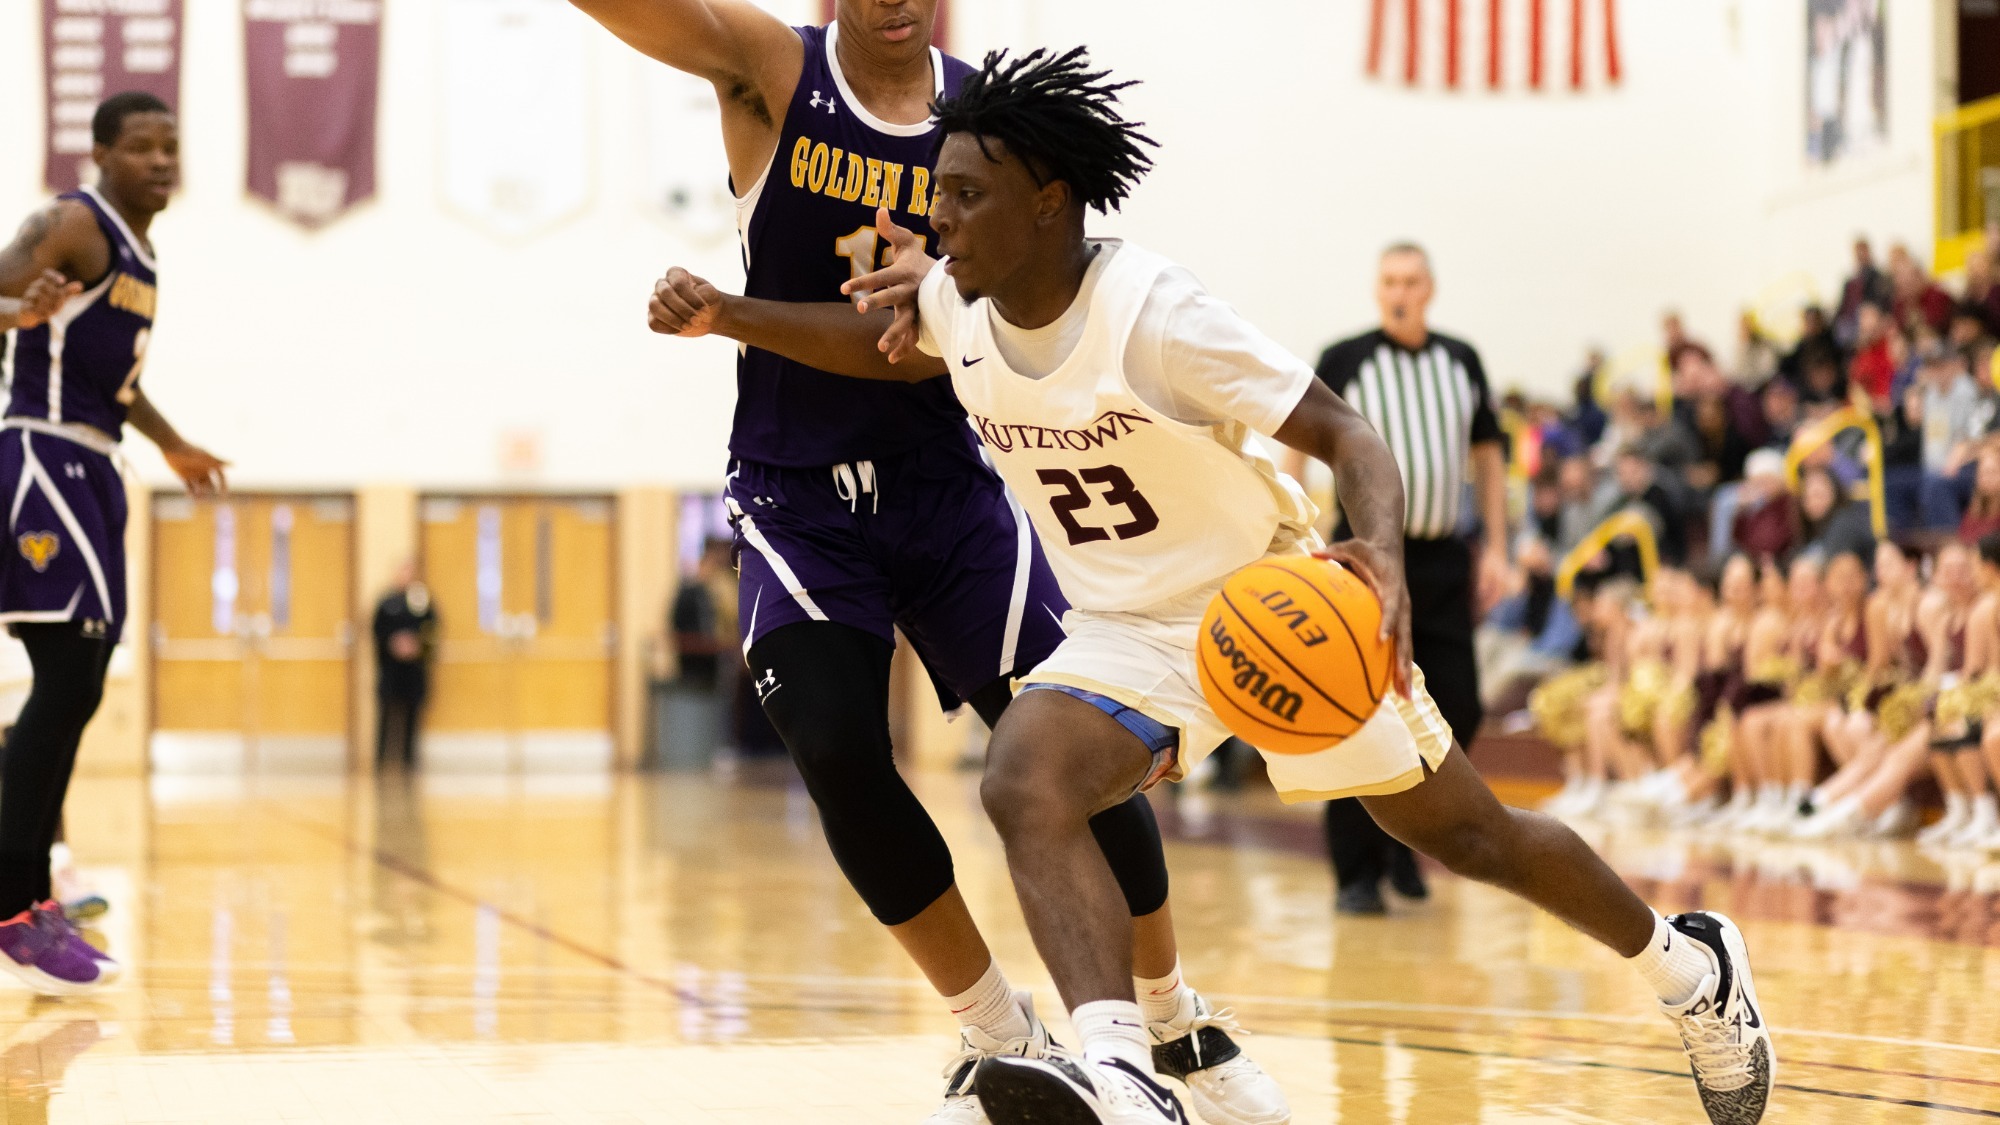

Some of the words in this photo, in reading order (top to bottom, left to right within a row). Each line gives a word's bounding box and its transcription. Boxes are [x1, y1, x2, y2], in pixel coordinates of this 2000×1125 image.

[790, 136, 903, 211] GOLDEN
[835, 224, 927, 304] 1
[973, 408, 1153, 453] KUTZTOWN
[1035, 464, 1160, 546] 23
[1210, 612, 1304, 723] Wilson
